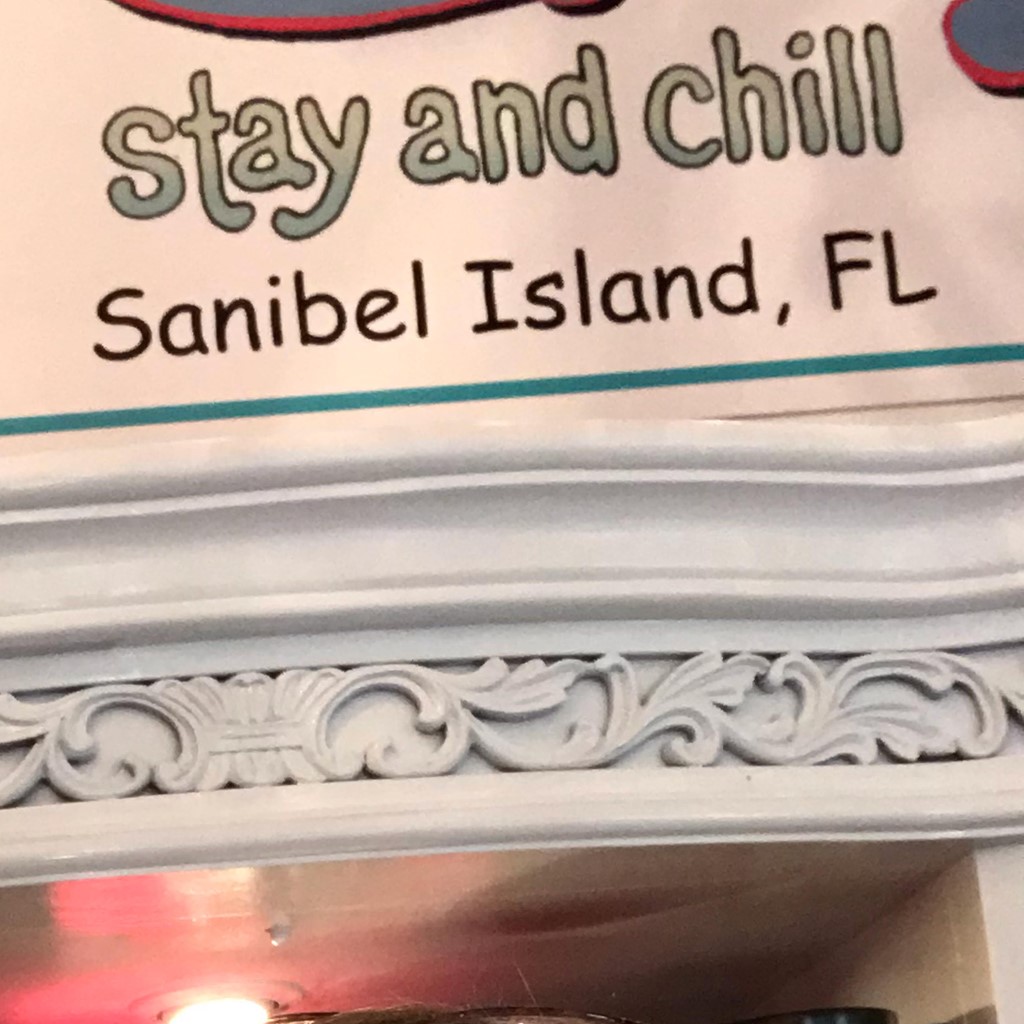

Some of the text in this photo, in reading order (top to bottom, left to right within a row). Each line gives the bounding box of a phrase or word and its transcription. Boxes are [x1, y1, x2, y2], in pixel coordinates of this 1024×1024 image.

[102, 24, 903, 239] stay and chill
[93, 230, 938, 361] Sanibel Island, FL
